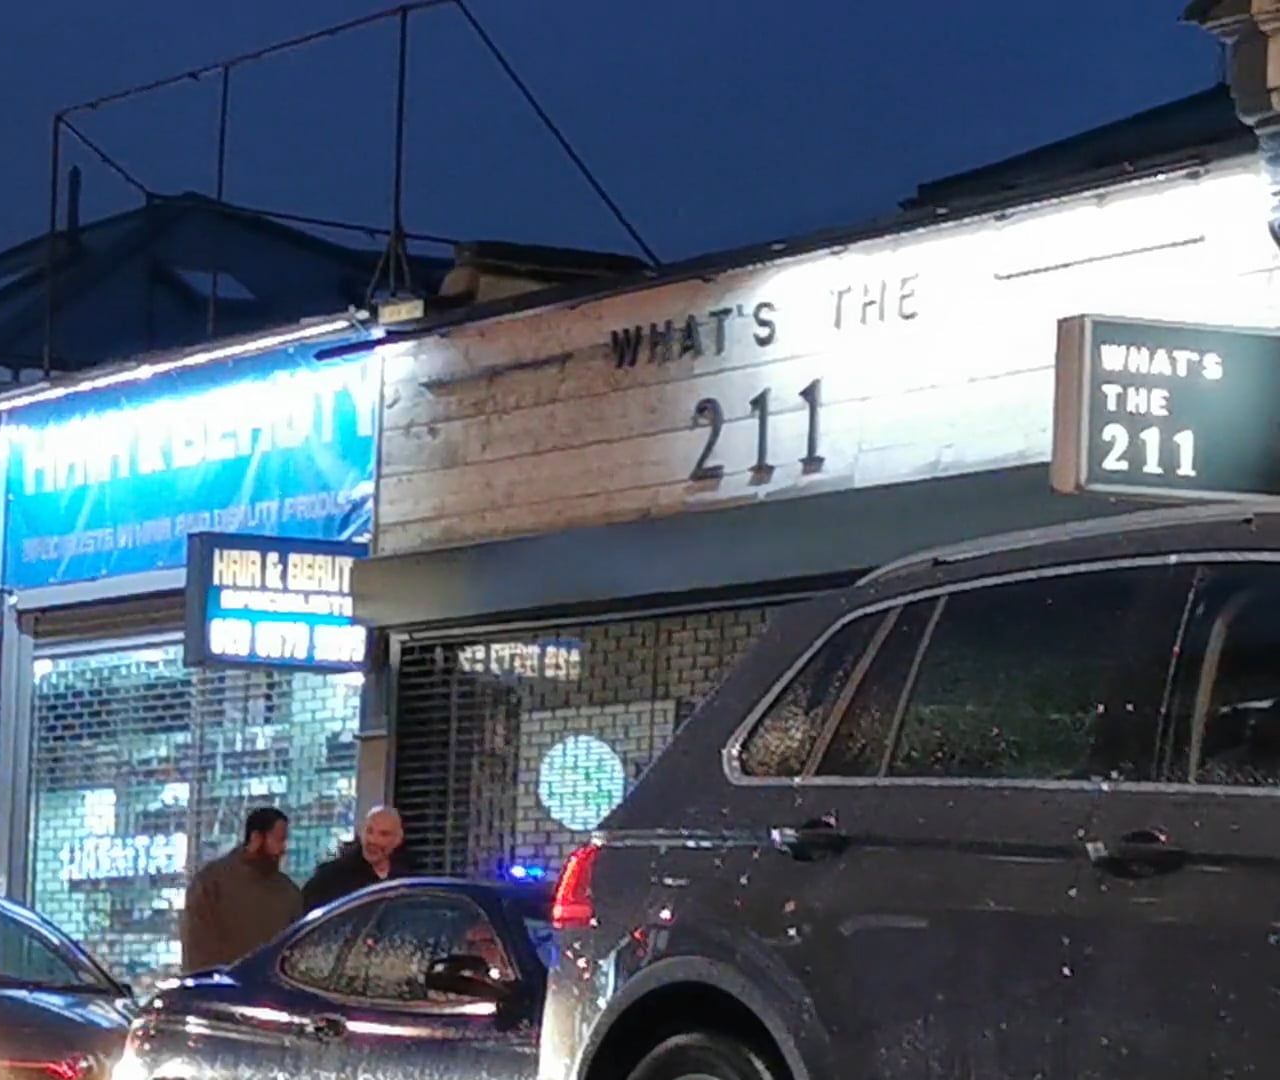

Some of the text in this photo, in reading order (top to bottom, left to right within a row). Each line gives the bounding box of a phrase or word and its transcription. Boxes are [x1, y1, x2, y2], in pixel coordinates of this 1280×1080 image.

[610, 273, 920, 368] WHAT'S THE
[1100, 343, 1223, 379] WHAT'S
[1101, 383, 1169, 416] THE
[689, 378, 825, 485] 211
[1101, 423, 1197, 476] 211
[213, 548, 354, 592] HAIR & BEAUT
